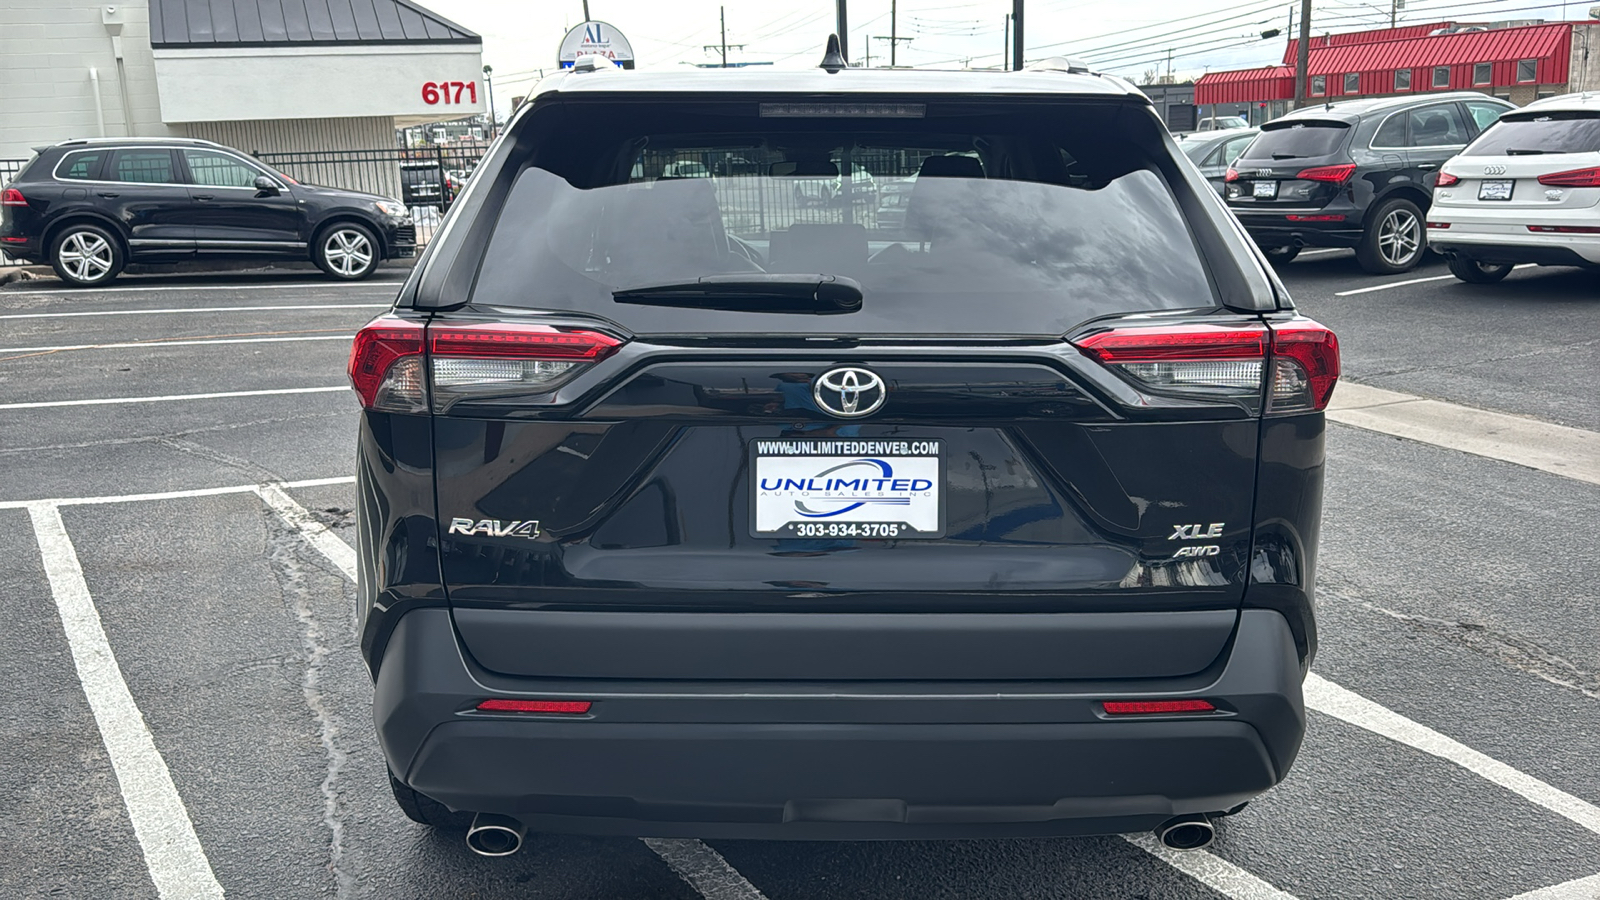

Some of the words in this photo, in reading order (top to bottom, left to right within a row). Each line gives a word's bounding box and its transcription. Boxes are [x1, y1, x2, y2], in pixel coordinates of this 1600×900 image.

[581, 23, 610, 44] AL
[421, 81, 477, 105] 6171
[757, 441, 939, 455] WWWUNLIMITEDDENVE.COM
[760, 478, 933, 492] UNLIMITED
[448, 517, 541, 540] RAV4
[796, 523, 899, 537] 303-934-3705
[1167, 522, 1226, 540] XLE
[1172, 545, 1221, 558] AWD
